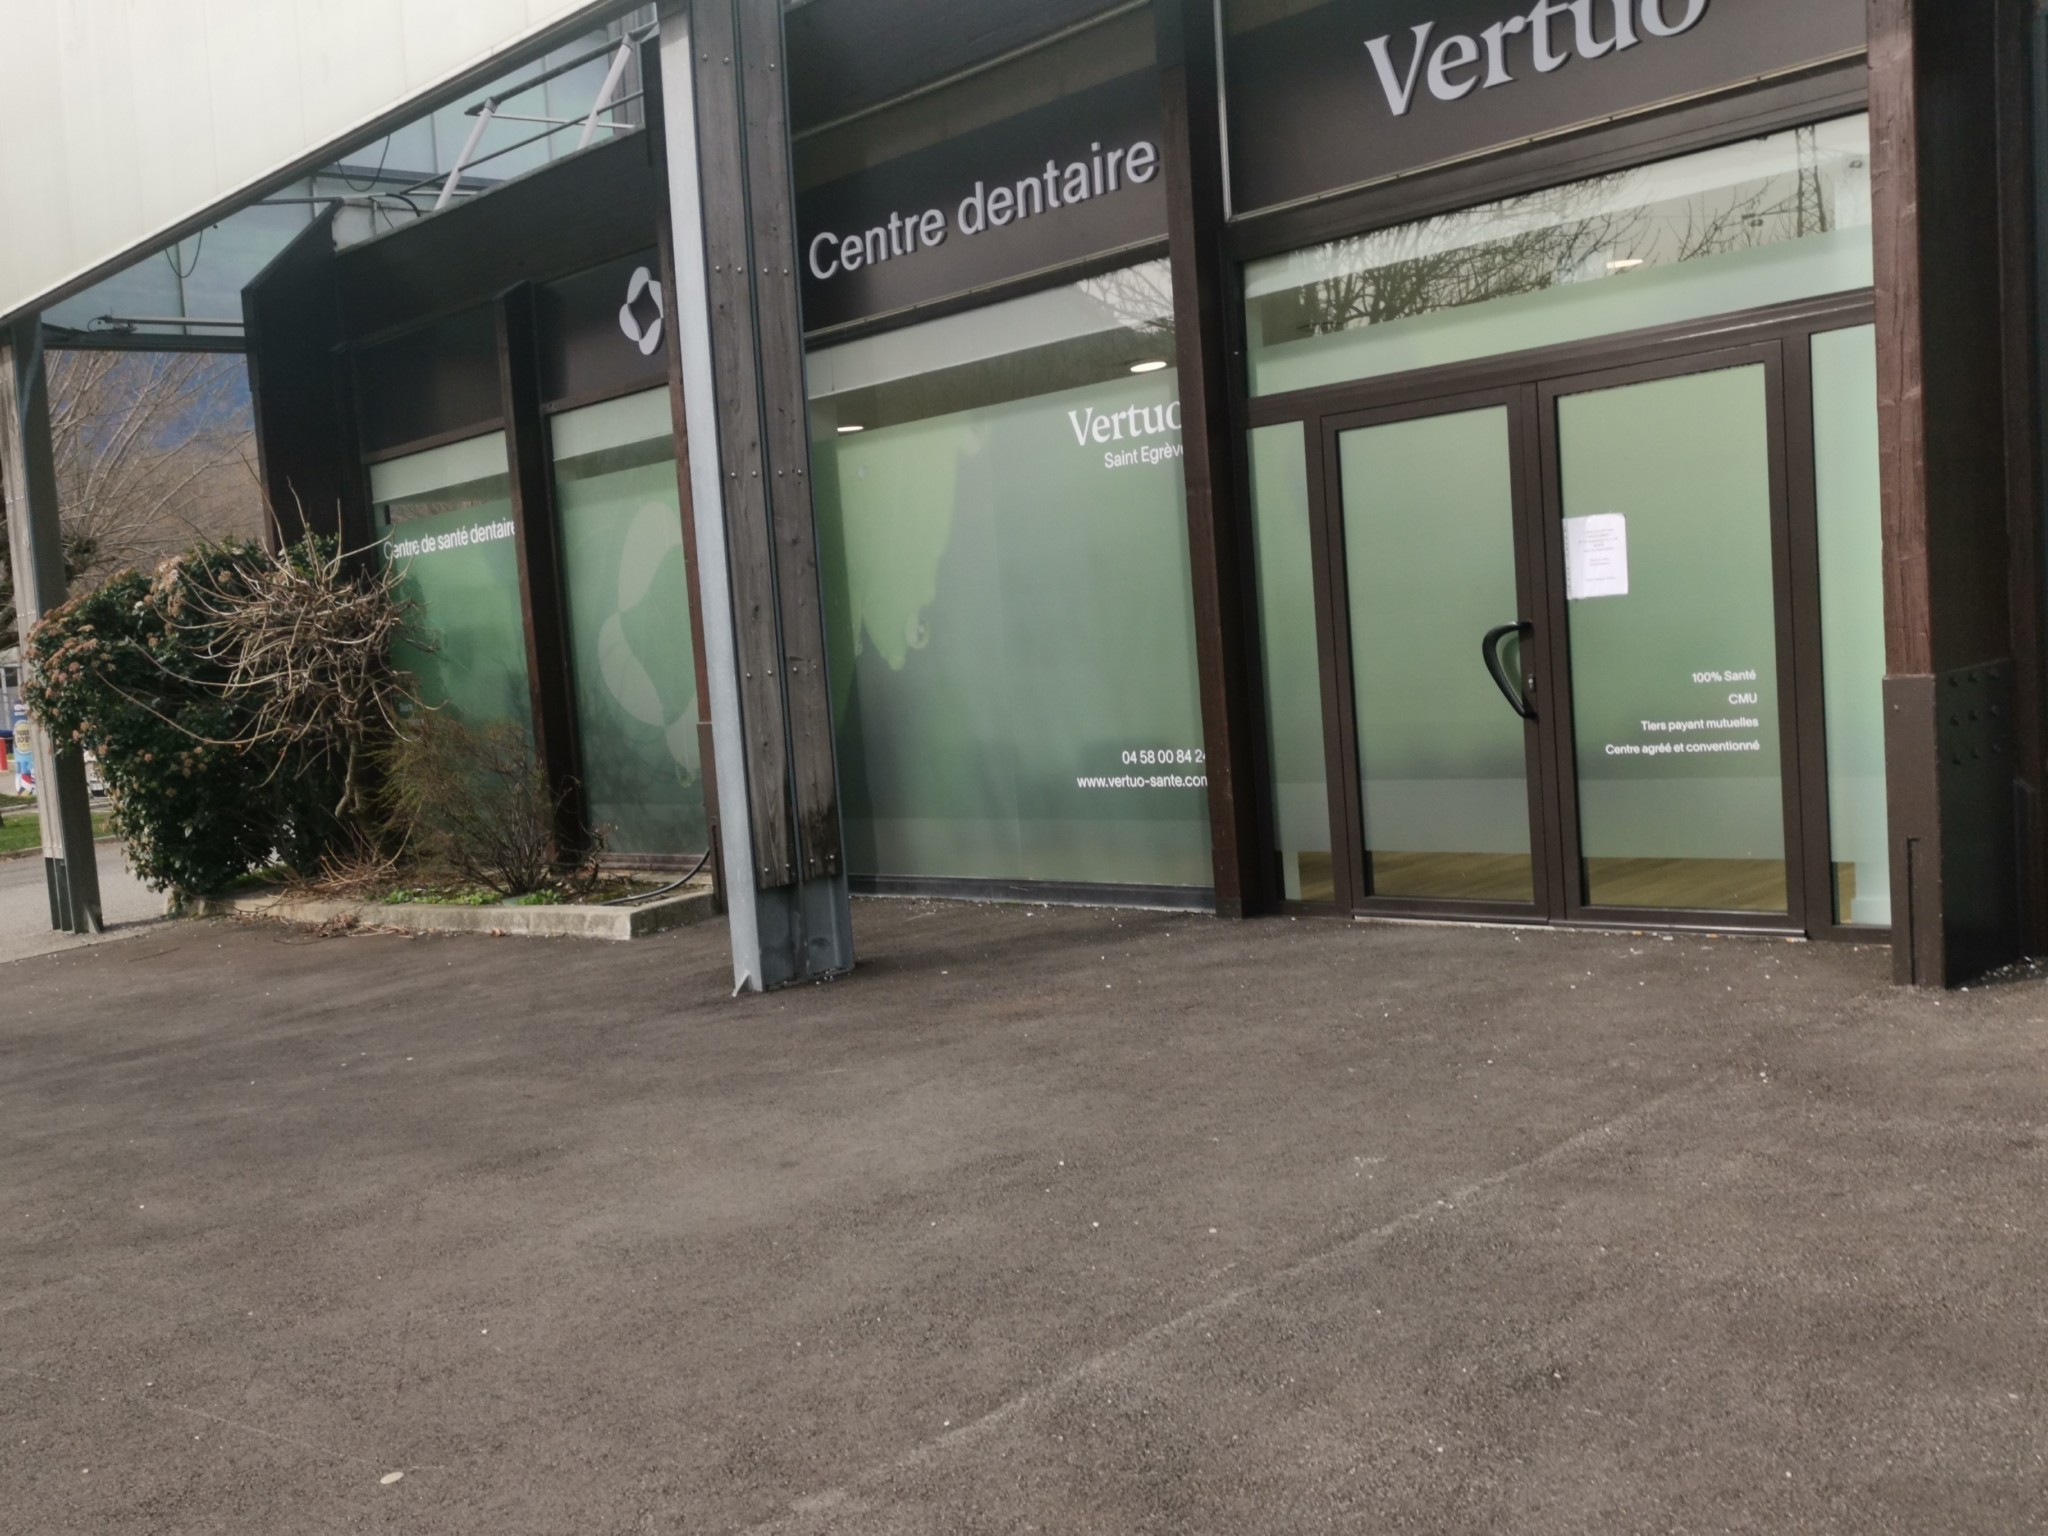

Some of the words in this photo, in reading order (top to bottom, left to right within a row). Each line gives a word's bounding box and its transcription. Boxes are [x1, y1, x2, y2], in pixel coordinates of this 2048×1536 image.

[809, 208, 947, 280] Centre
[957, 140, 1158, 236] dentaire
[1104, 448, 1138, 469] Saint
[383, 538, 420, 560] Centre
[421, 532, 436, 554] de
[437, 525, 469, 551] santé
[1691, 671, 1723, 684] 100%
[1724, 668, 1757, 682] Santé
[1728, 692, 1758, 705] CMU
[1641, 720, 1667, 732] Tiers
[1668, 718, 1705, 733] payant
[1706, 716, 1760, 729] mutuelles
[1605, 743, 1641, 756] Centre
[1642, 742, 1672, 756] agréé
[1673, 741, 1685, 753] et
[1686, 739, 1761, 753] conventionné
[1122, 750, 1138, 765] 04
[1139, 749, 1156, 764] 58
[1157, 749, 1174, 764] 00
[1176, 748, 1192, 764] 84
